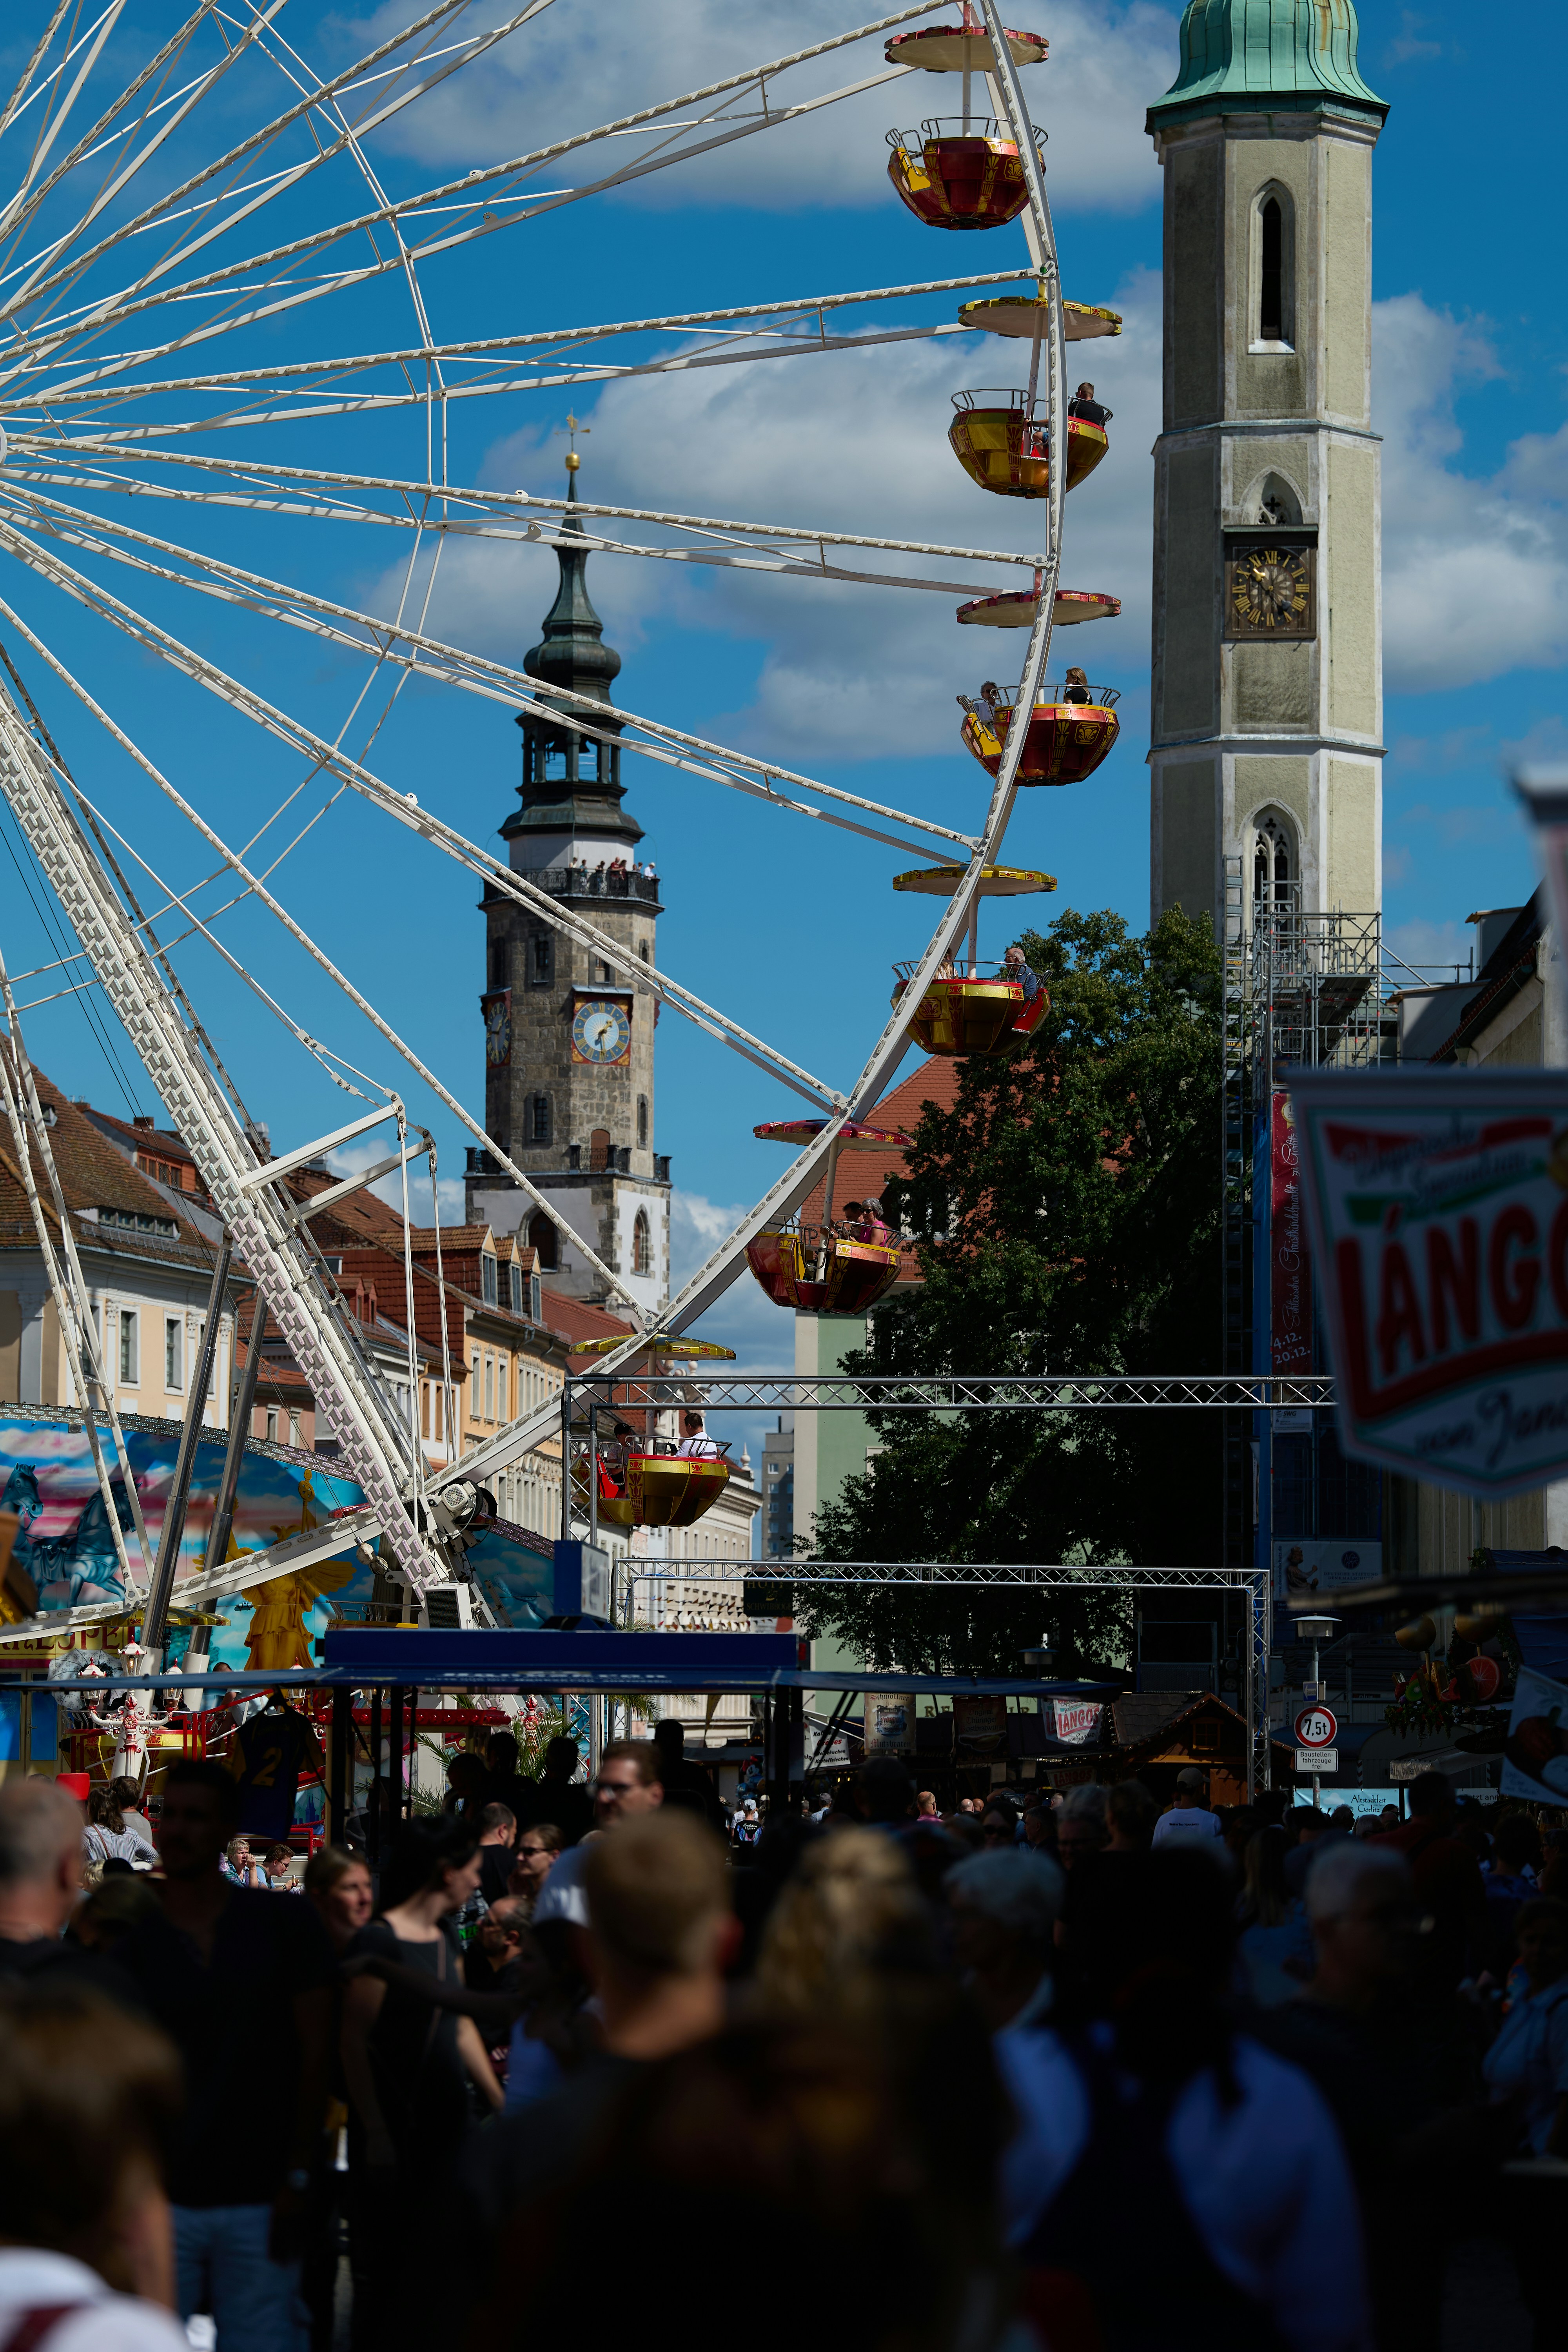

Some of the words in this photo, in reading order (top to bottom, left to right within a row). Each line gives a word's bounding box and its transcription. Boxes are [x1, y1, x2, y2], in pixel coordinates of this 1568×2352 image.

[1264, 550, 1278, 564] XII
[1236, 566, 1251, 579] X
[1291, 567, 1306, 579] II
[1232, 584, 1246, 593] IX
[1296, 584, 1309, 593] III
[1234, 595, 1252, 613] VIII
[1247, 608, 1261, 624] VII
[1266, 612, 1275, 626] VI
[1279, 1180, 1300, 1272] Christkindelmarkt
[1292, 1167, 1300, 1176] zu
[1274, 1332, 1302, 1349] 4.12.
[1274, 1346, 1311, 1365] 20.12.
[969, 1708, 993, 1717] Original
[1058, 1707, 1100, 1738] LÁNGOS
[870, 1739, 911, 1748] Mutzbraten
[251, 1747, 283, 1788] 2
[1053, 1769, 1092, 1788] LÁNGOS
[1351, 1794, 1386, 1803] Altstadtfest
[1357, 1804, 1380, 1813] Görlitz
